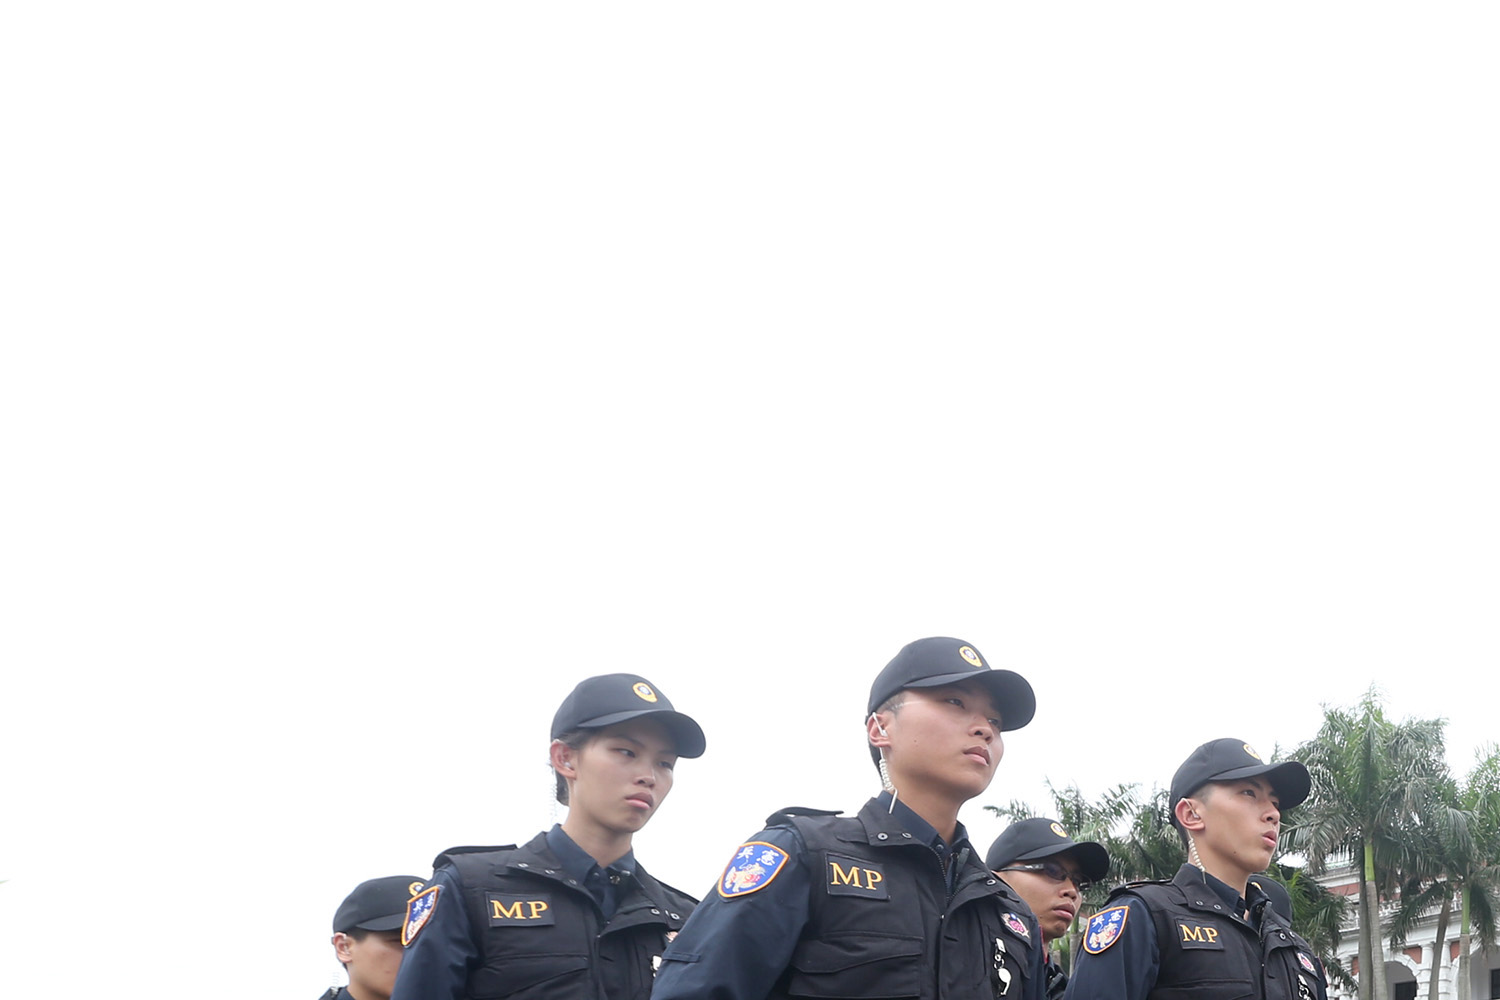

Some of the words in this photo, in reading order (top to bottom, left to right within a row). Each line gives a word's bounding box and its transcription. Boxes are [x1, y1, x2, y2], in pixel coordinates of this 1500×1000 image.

[829, 862, 883, 890] MP
[490, 899, 549, 920] MP
[1179, 923, 1219, 943] MP
